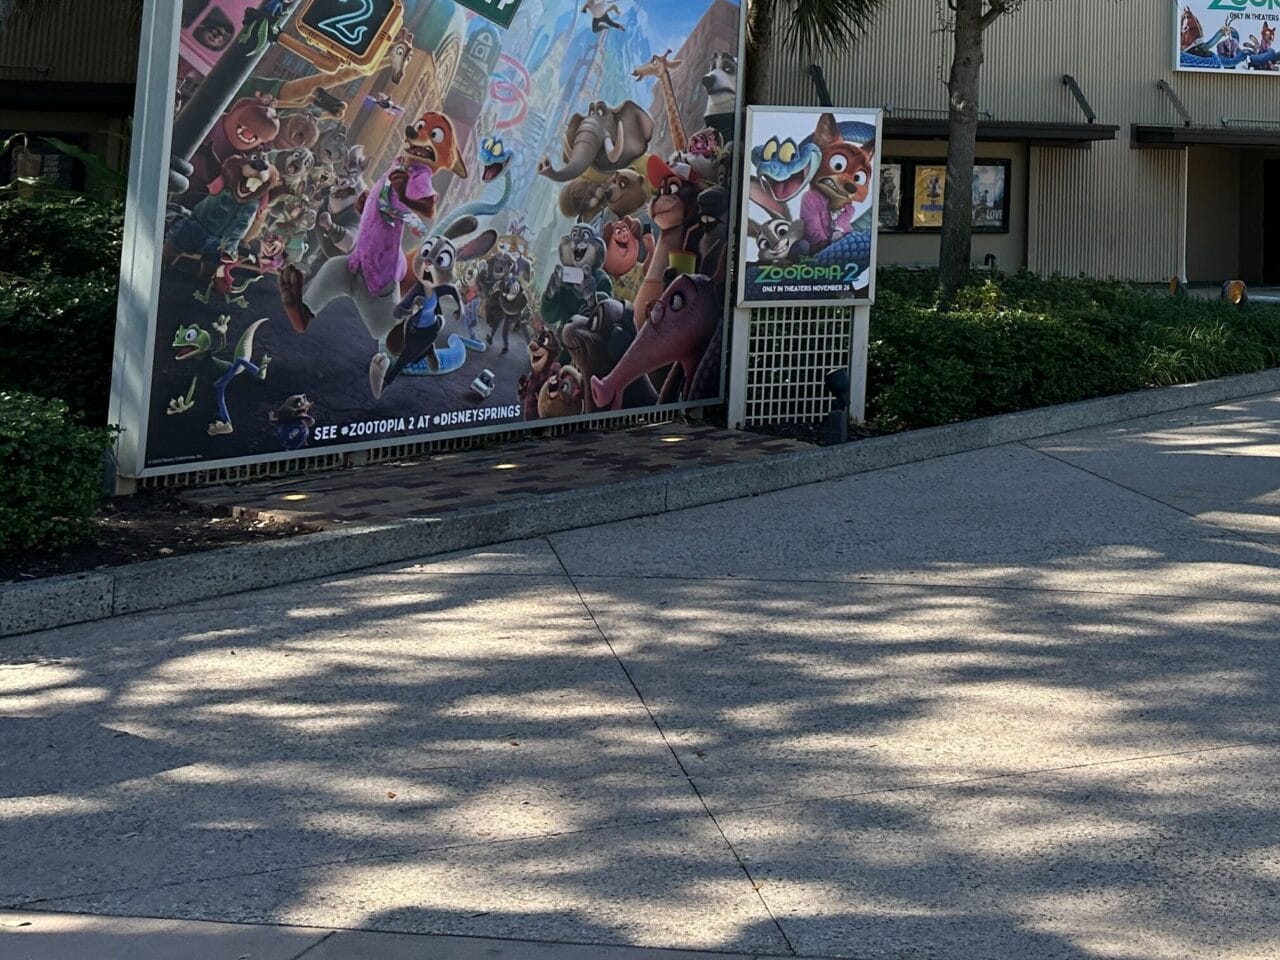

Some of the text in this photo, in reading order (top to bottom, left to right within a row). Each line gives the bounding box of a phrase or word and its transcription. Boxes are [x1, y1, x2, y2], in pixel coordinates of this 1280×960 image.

[1251, 13, 1280, 22] THEATERS
[754, 262, 860, 284] ZOOTOPIA 2
[813, 284, 842, 292] NOVEMBER
[314, 404, 521, 441] SEE #ZOOTOPIA 2 AT #DISNEYSPRINGS
